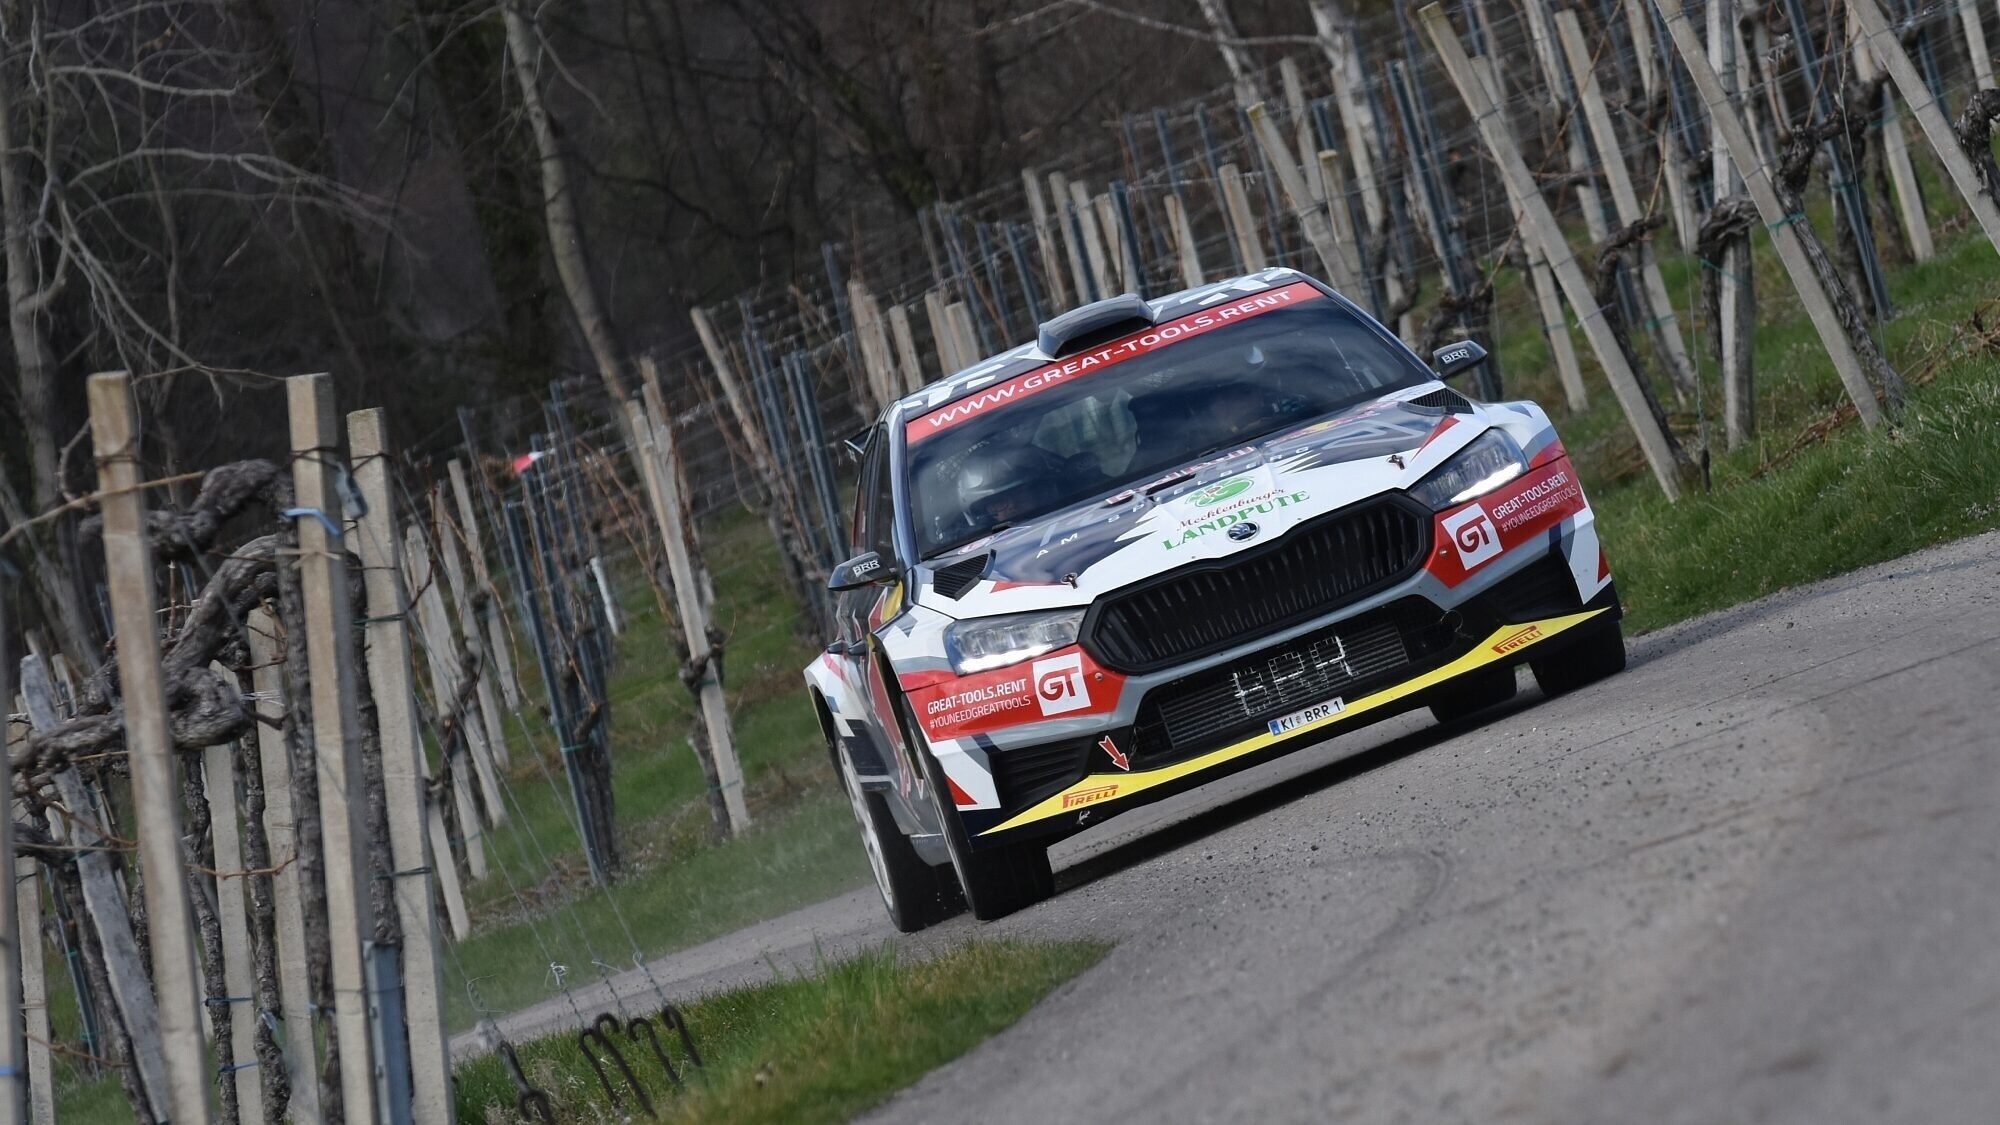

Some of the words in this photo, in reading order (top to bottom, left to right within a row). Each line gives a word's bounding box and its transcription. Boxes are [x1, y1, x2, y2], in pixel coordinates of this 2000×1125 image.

[929, 290, 1291, 427] WWW.GREAT-TOOLS.RENT
[1441, 348, 1470, 364] BRR
[1177, 487, 1286, 531] Mecklenburger
[1492, 471, 1569, 520] GREAT-TOOLS.RENT
[1501, 487, 1578, 533] #YOUNEEDGREATTOOLS
[1162, 490, 1310, 550] LANDPUTE
[1455, 515, 1487, 554] GT
[852, 559, 880, 578] BRR
[1492, 625, 1543, 654] PIRELLI
[927, 678, 1027, 715] GREAT-TOOLS.RENT
[1038, 666, 1079, 701] GT
[929, 694, 1031, 729] #YOUNEEDGREATTOOLS
[1281, 717, 1294, 730] KI
[1304, 705, 1330, 722] BRR
[1333, 701, 1341, 711] 1
[1062, 785, 1119, 809] PIRELLI
